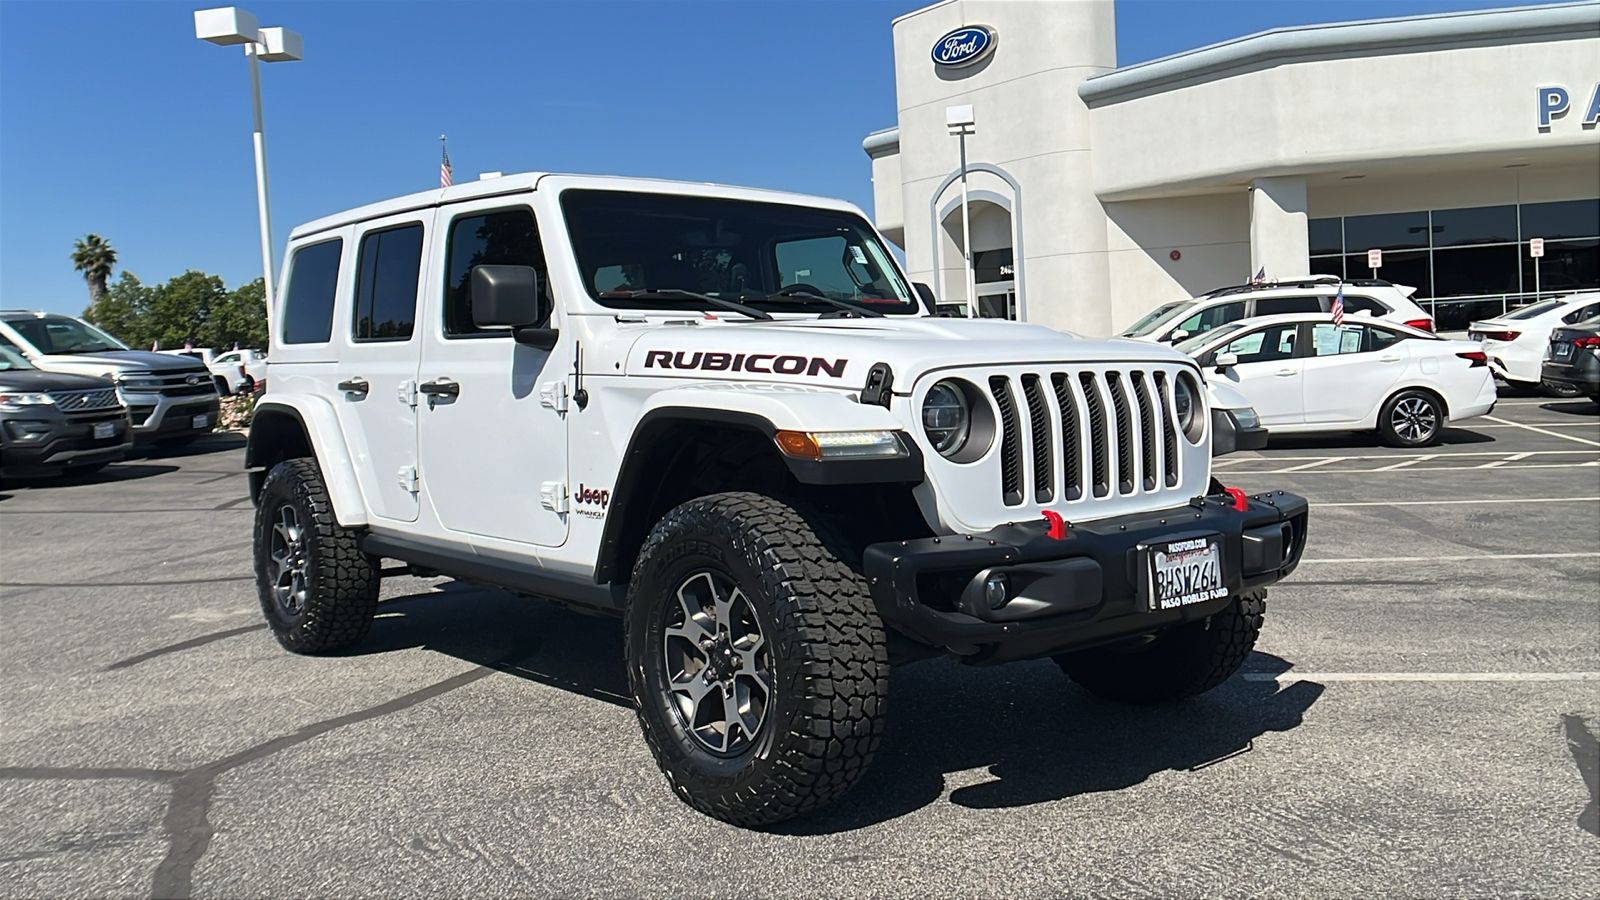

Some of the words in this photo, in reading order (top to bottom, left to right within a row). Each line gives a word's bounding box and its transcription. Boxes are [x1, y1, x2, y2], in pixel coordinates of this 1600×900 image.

[942, 33, 978, 61] Ford
[644, 350, 848, 378] RUBICON
[575, 483, 610, 509] Jeep
[1160, 598, 1181, 610] PASO
[1181, 591, 1210, 606] ROBLES
